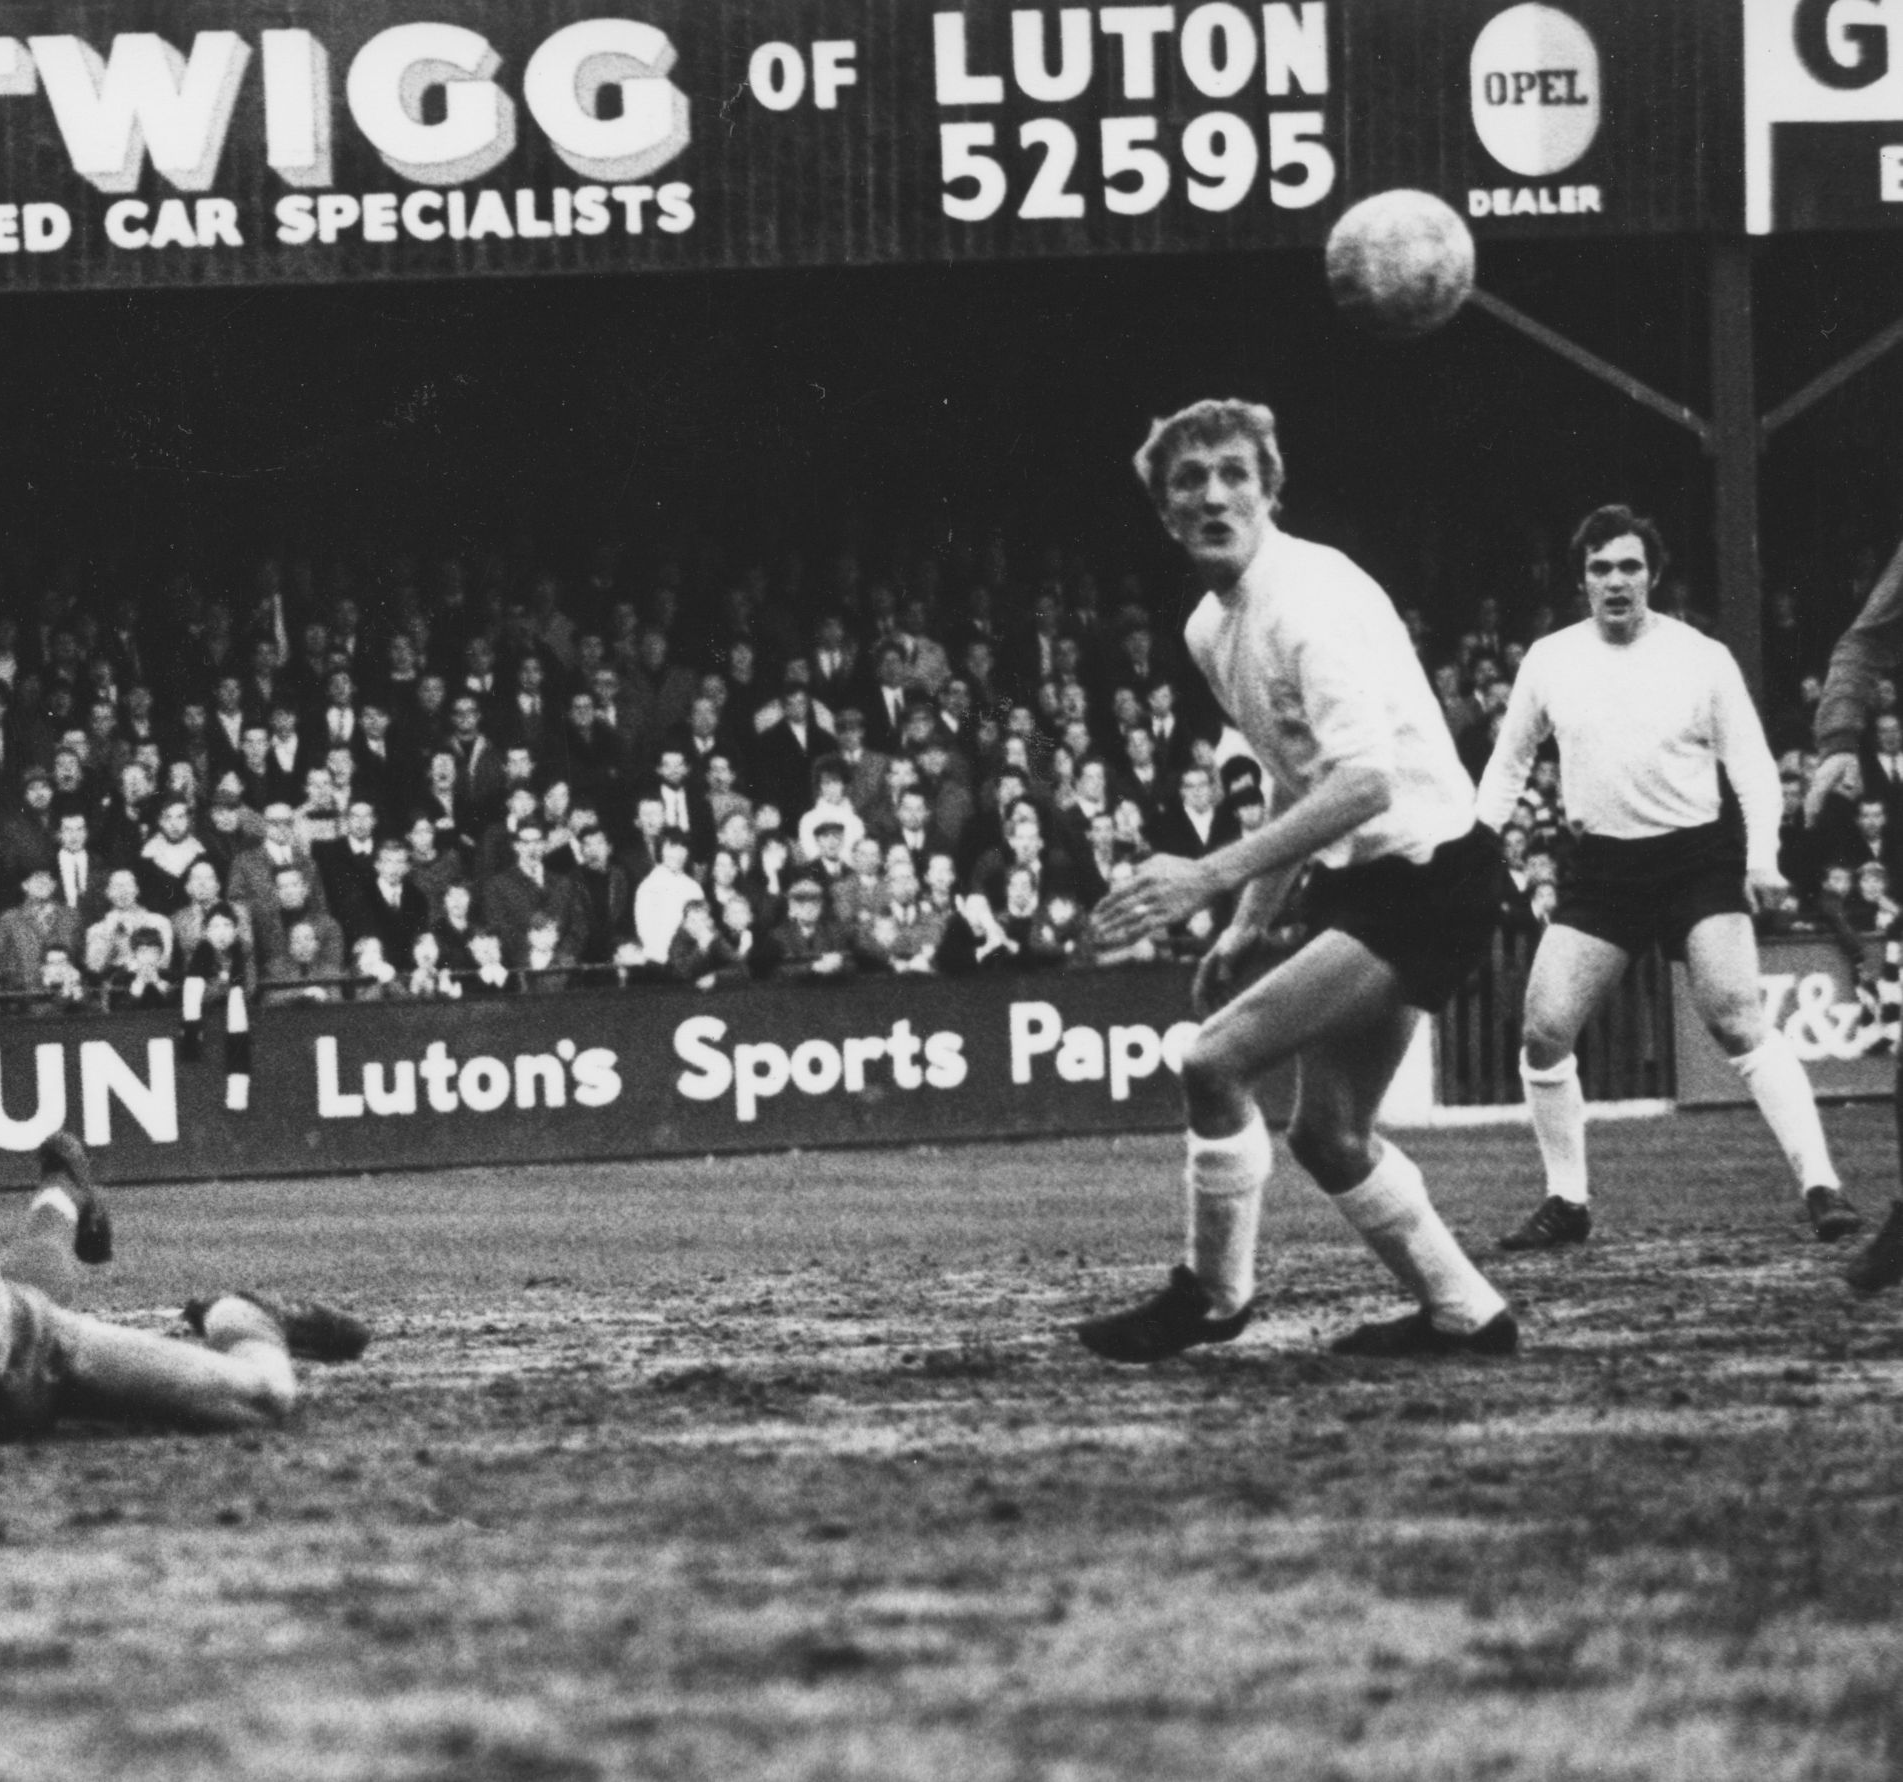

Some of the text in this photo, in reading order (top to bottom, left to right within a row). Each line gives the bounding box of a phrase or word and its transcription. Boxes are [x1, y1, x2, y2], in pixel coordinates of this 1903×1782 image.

[748, 39, 857, 110] OF
[933, 1, 1329, 105] LUTON
[1486, 69, 1588, 107] OPEL
[939, 112, 1335, 222] 52595
[1467, 184, 1603, 219] DEALER
[104, 198, 244, 250] CAR
[274, 183, 695, 245] SPECIALISTS
[315, 1034, 622, 1118] Luton's
[673, 1014, 968, 1122] Sports
